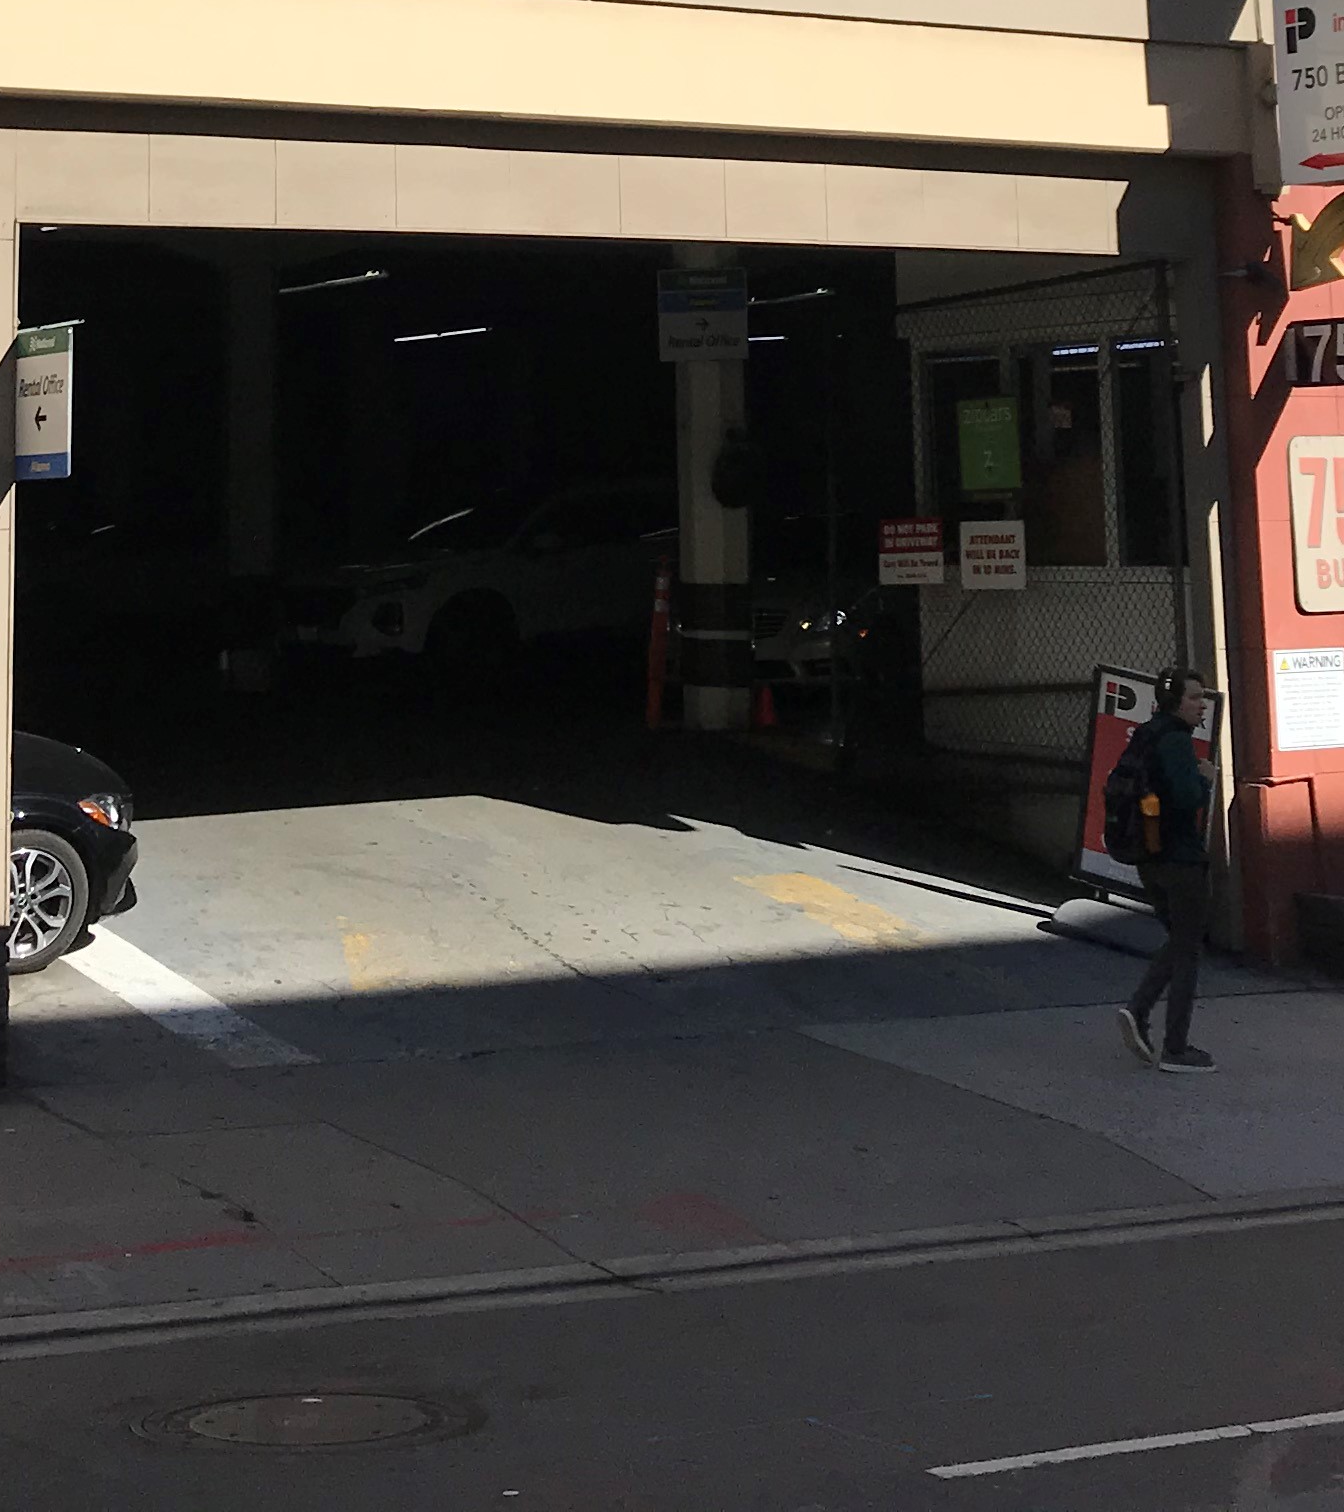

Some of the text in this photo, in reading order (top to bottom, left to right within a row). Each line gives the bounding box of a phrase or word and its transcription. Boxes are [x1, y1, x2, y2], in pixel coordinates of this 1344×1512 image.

[1291, 65, 1328, 91] 750
[1312, 128, 1327, 143] 24
[17, 374, 64, 398] Rental Office
[1292, 655, 1341, 669] WARNING
